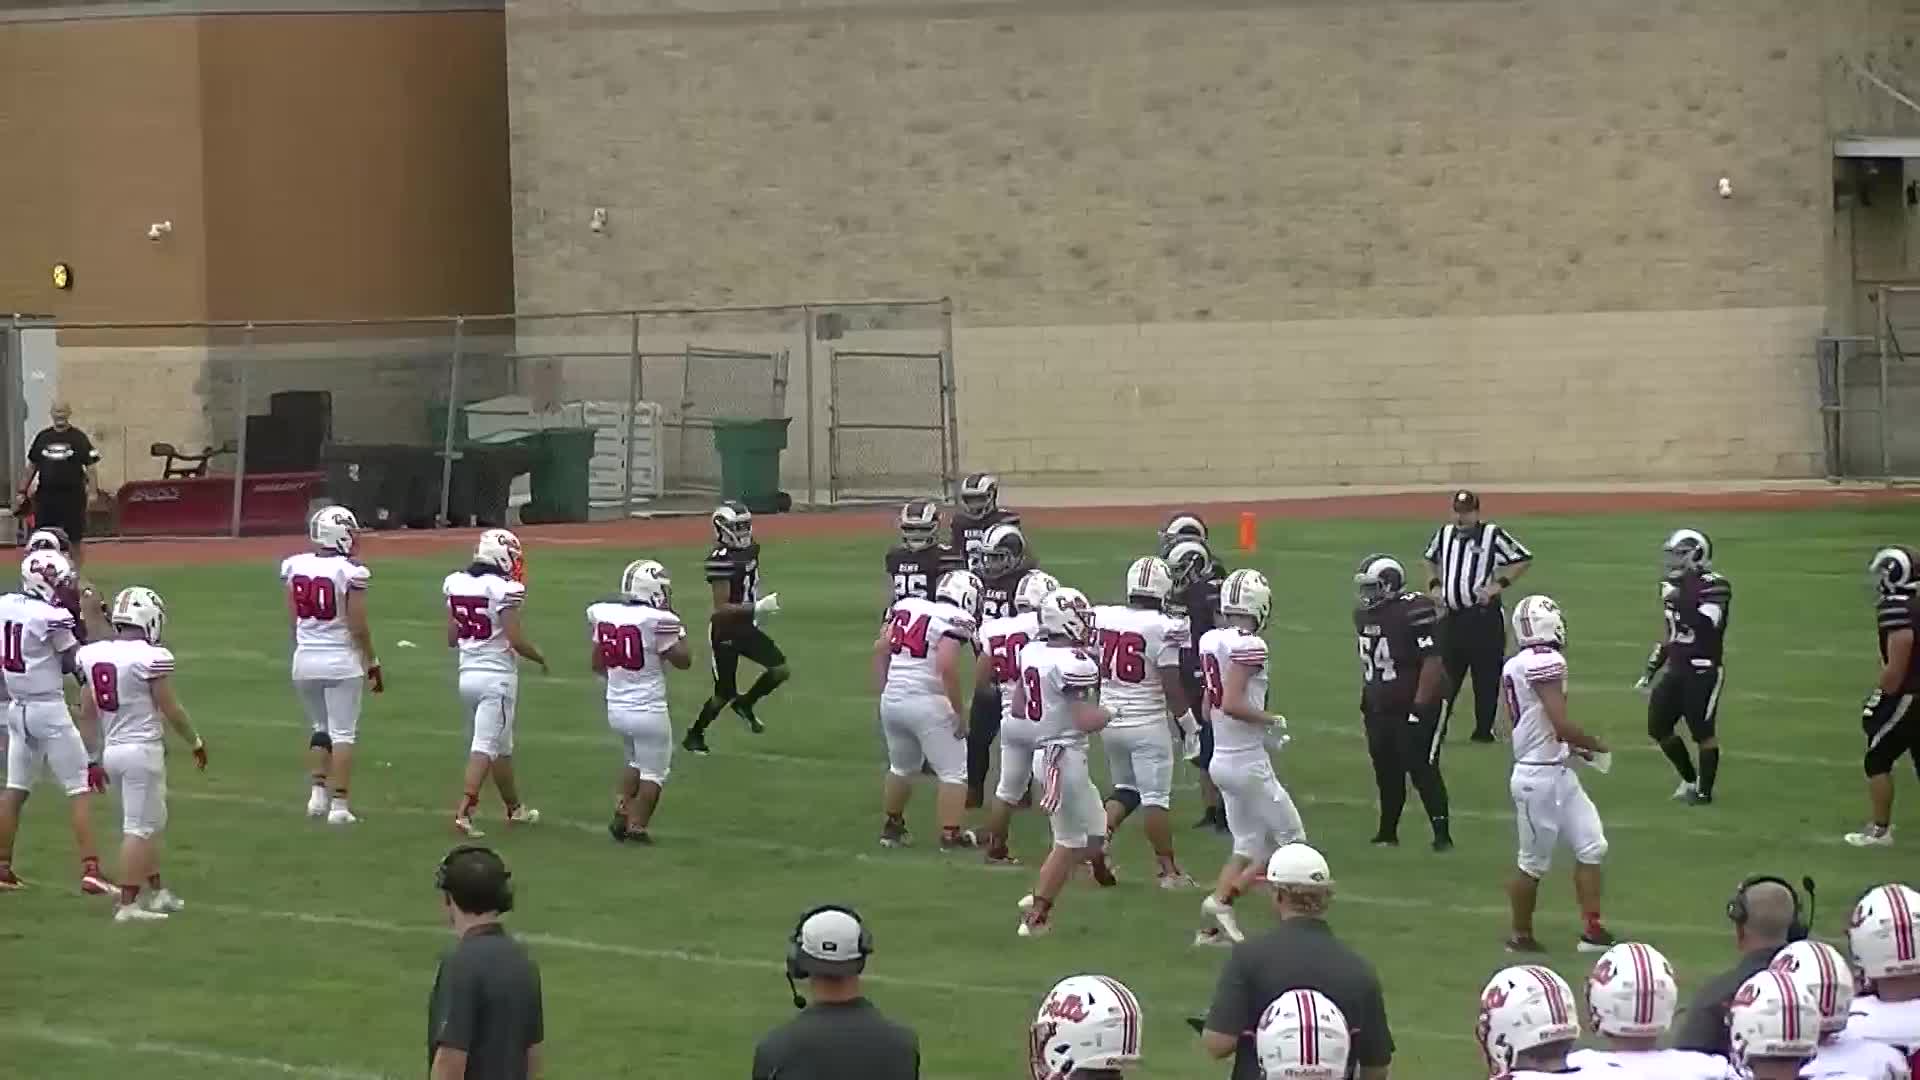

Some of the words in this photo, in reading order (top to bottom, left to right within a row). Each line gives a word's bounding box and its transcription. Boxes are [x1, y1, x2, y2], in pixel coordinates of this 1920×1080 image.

[450, 595, 492, 640] 55
[888, 610, 931, 658] 64
[1099, 628, 1147, 683] 76
[1359, 636, 1396, 681] 54
[92, 662, 119, 711] 8
